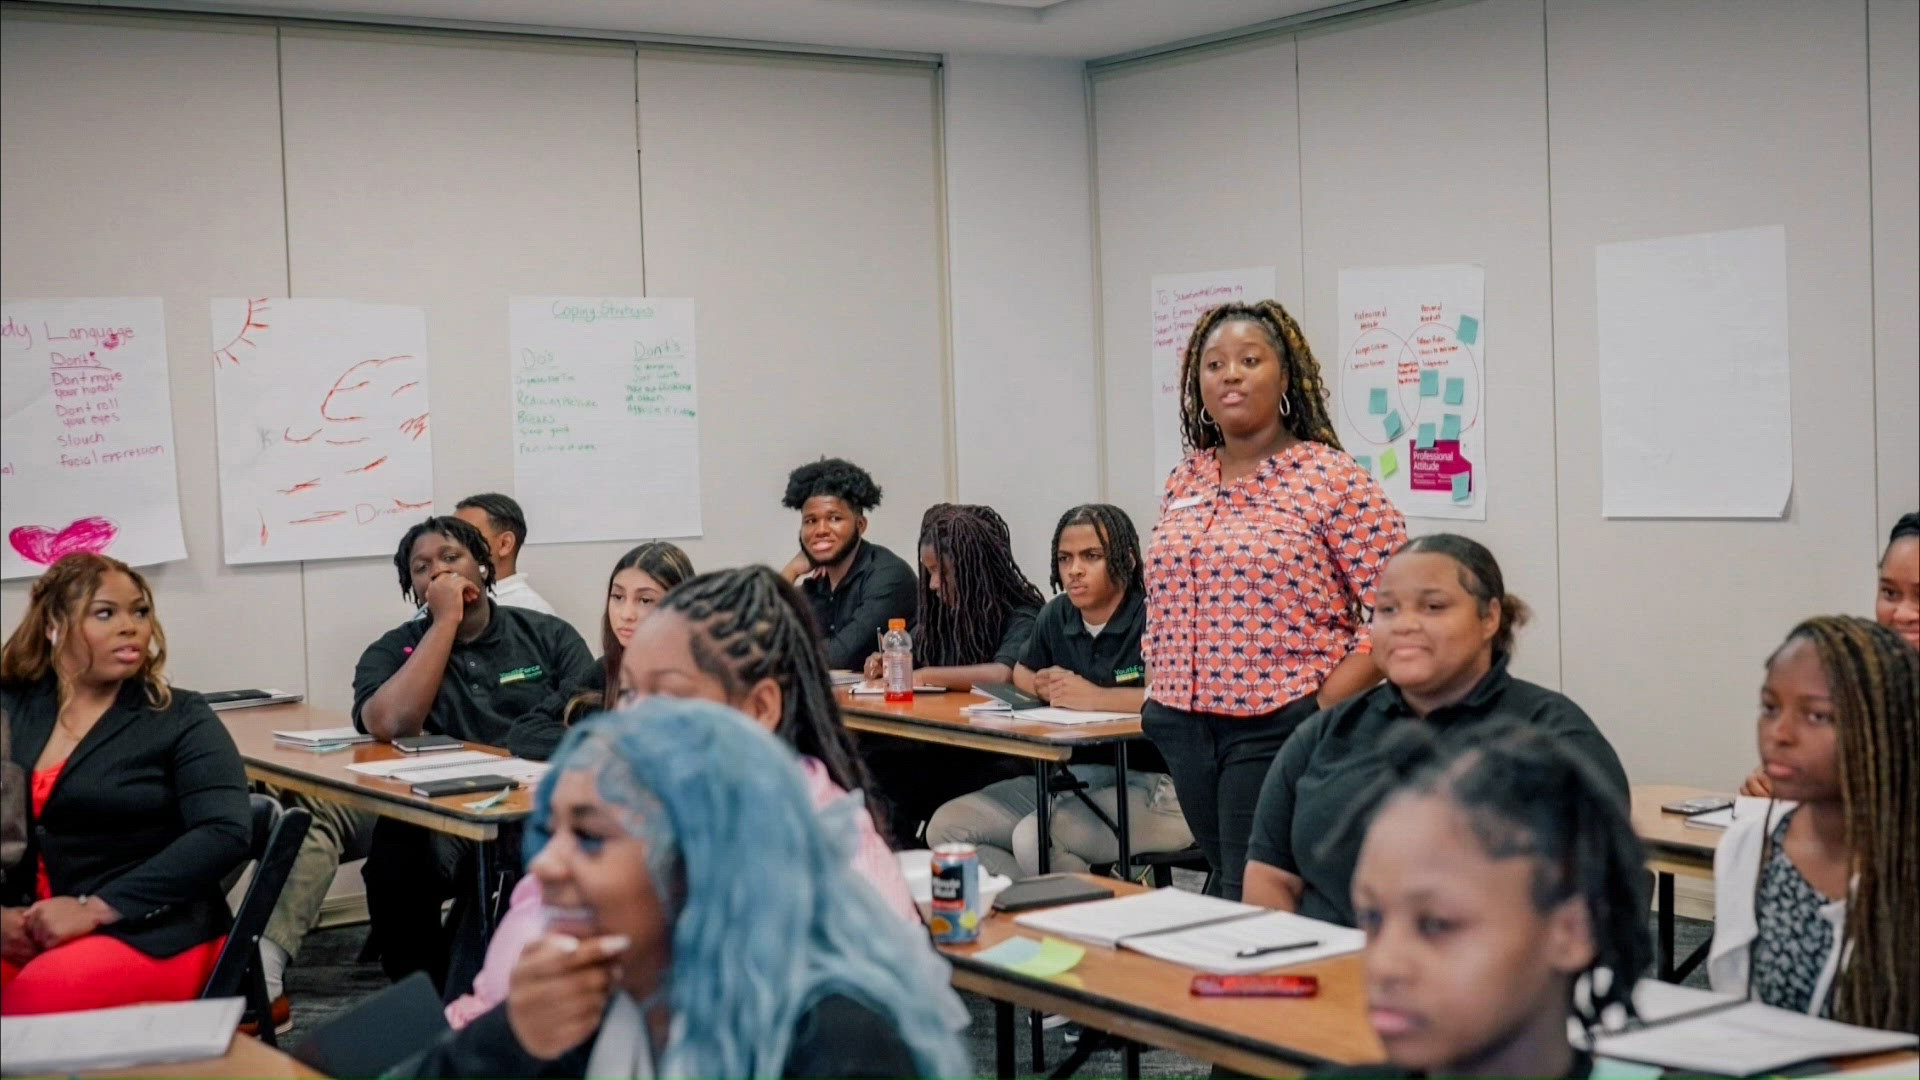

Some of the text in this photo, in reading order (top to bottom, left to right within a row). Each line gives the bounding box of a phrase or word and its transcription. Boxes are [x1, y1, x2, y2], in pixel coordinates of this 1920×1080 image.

[44, 320, 135, 347] Language
[57, 431, 105, 447] Slouch
[1413, 451, 1454, 461] Professional
[1413, 461, 1440, 471] Attitude
